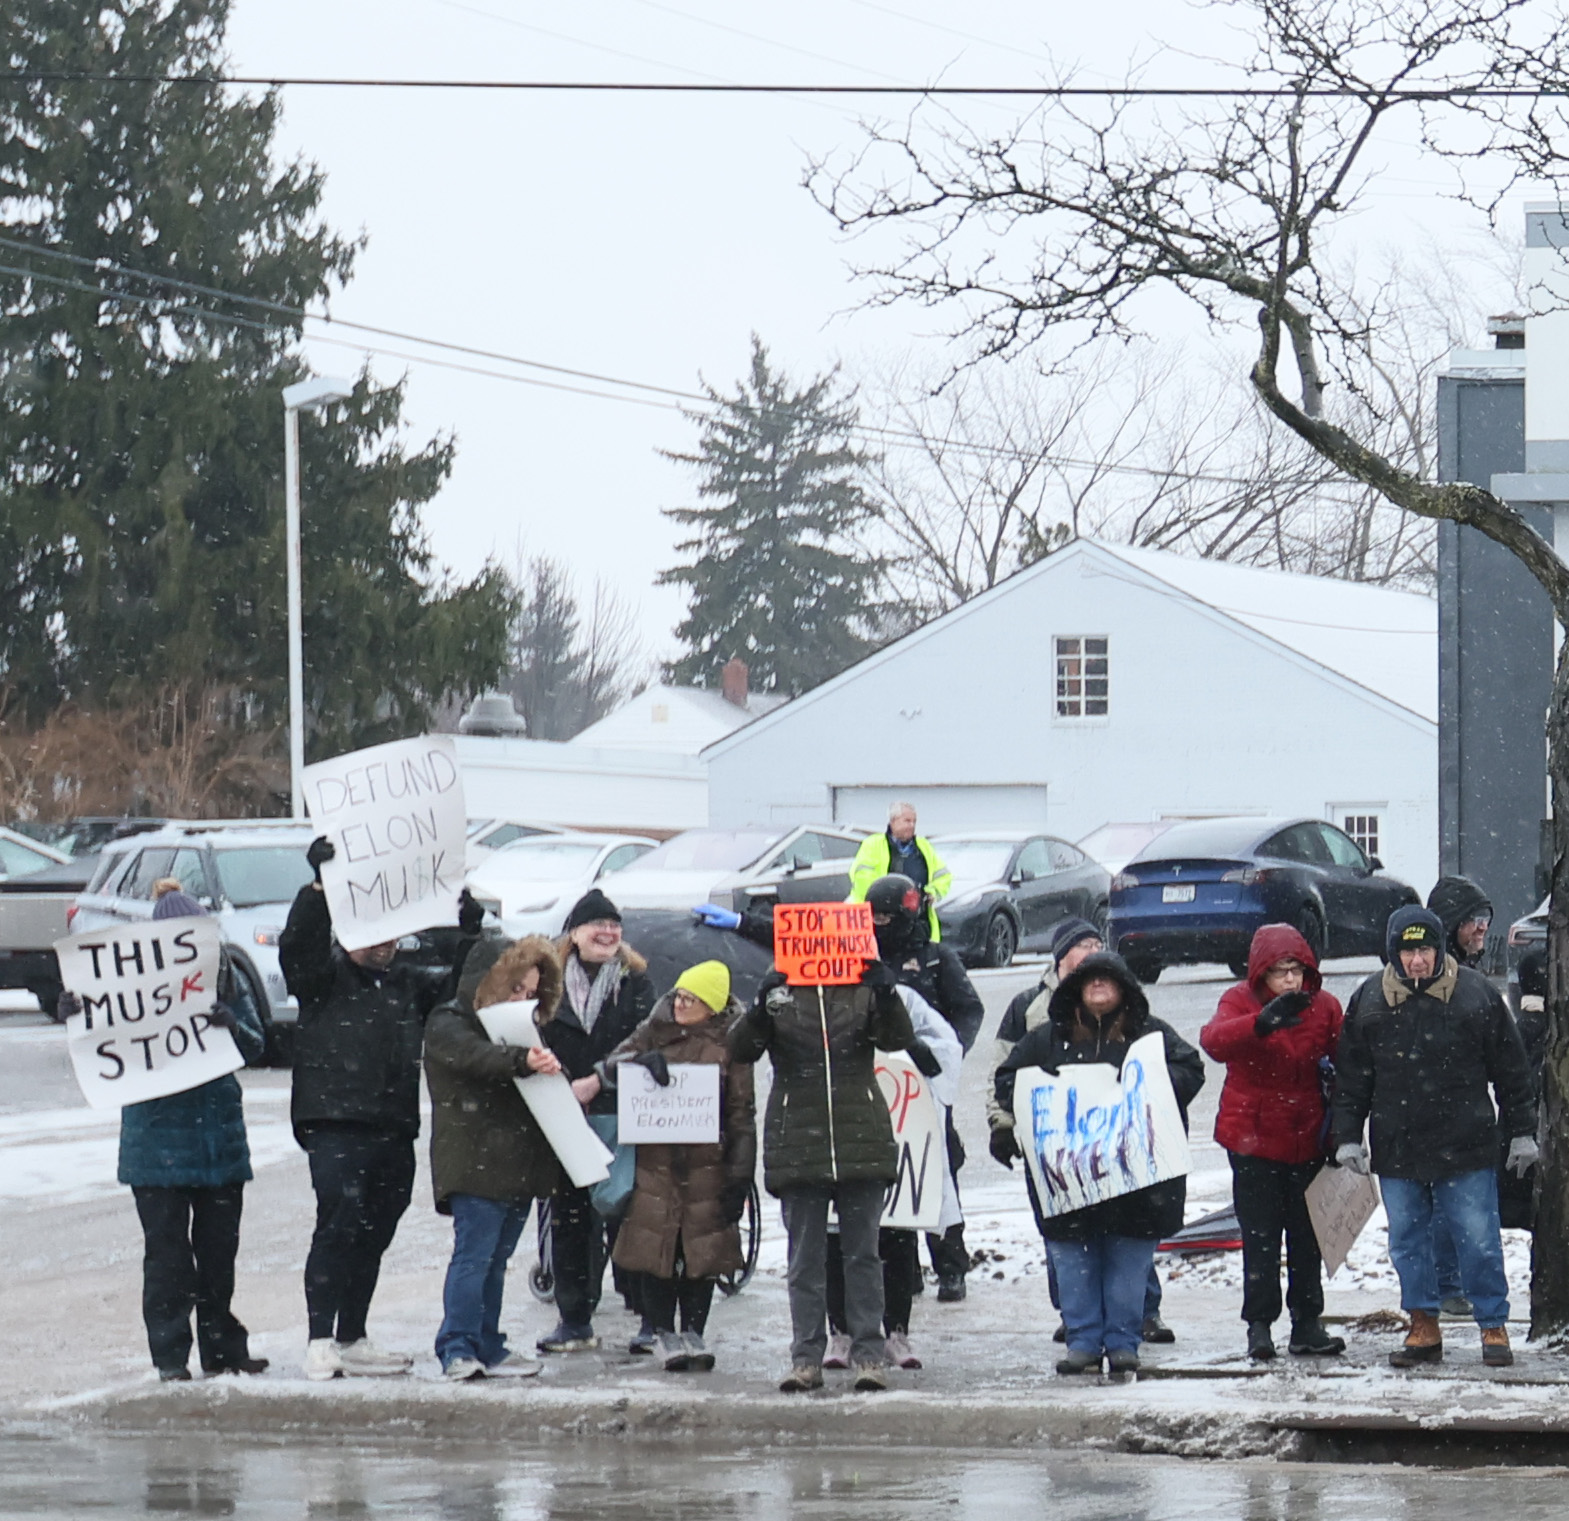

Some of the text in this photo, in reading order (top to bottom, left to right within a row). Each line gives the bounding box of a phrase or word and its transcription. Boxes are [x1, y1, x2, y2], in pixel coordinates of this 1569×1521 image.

[316, 750, 456, 815] DEFUND
[341, 807, 437, 862] ELON
[779, 908, 870, 933] STOP THE
[78, 929, 199, 979] THIS
[81, 970, 205, 1030] MUSK
[95, 1013, 211, 1080] STOP
[643, 1071, 689, 1093] SOP
